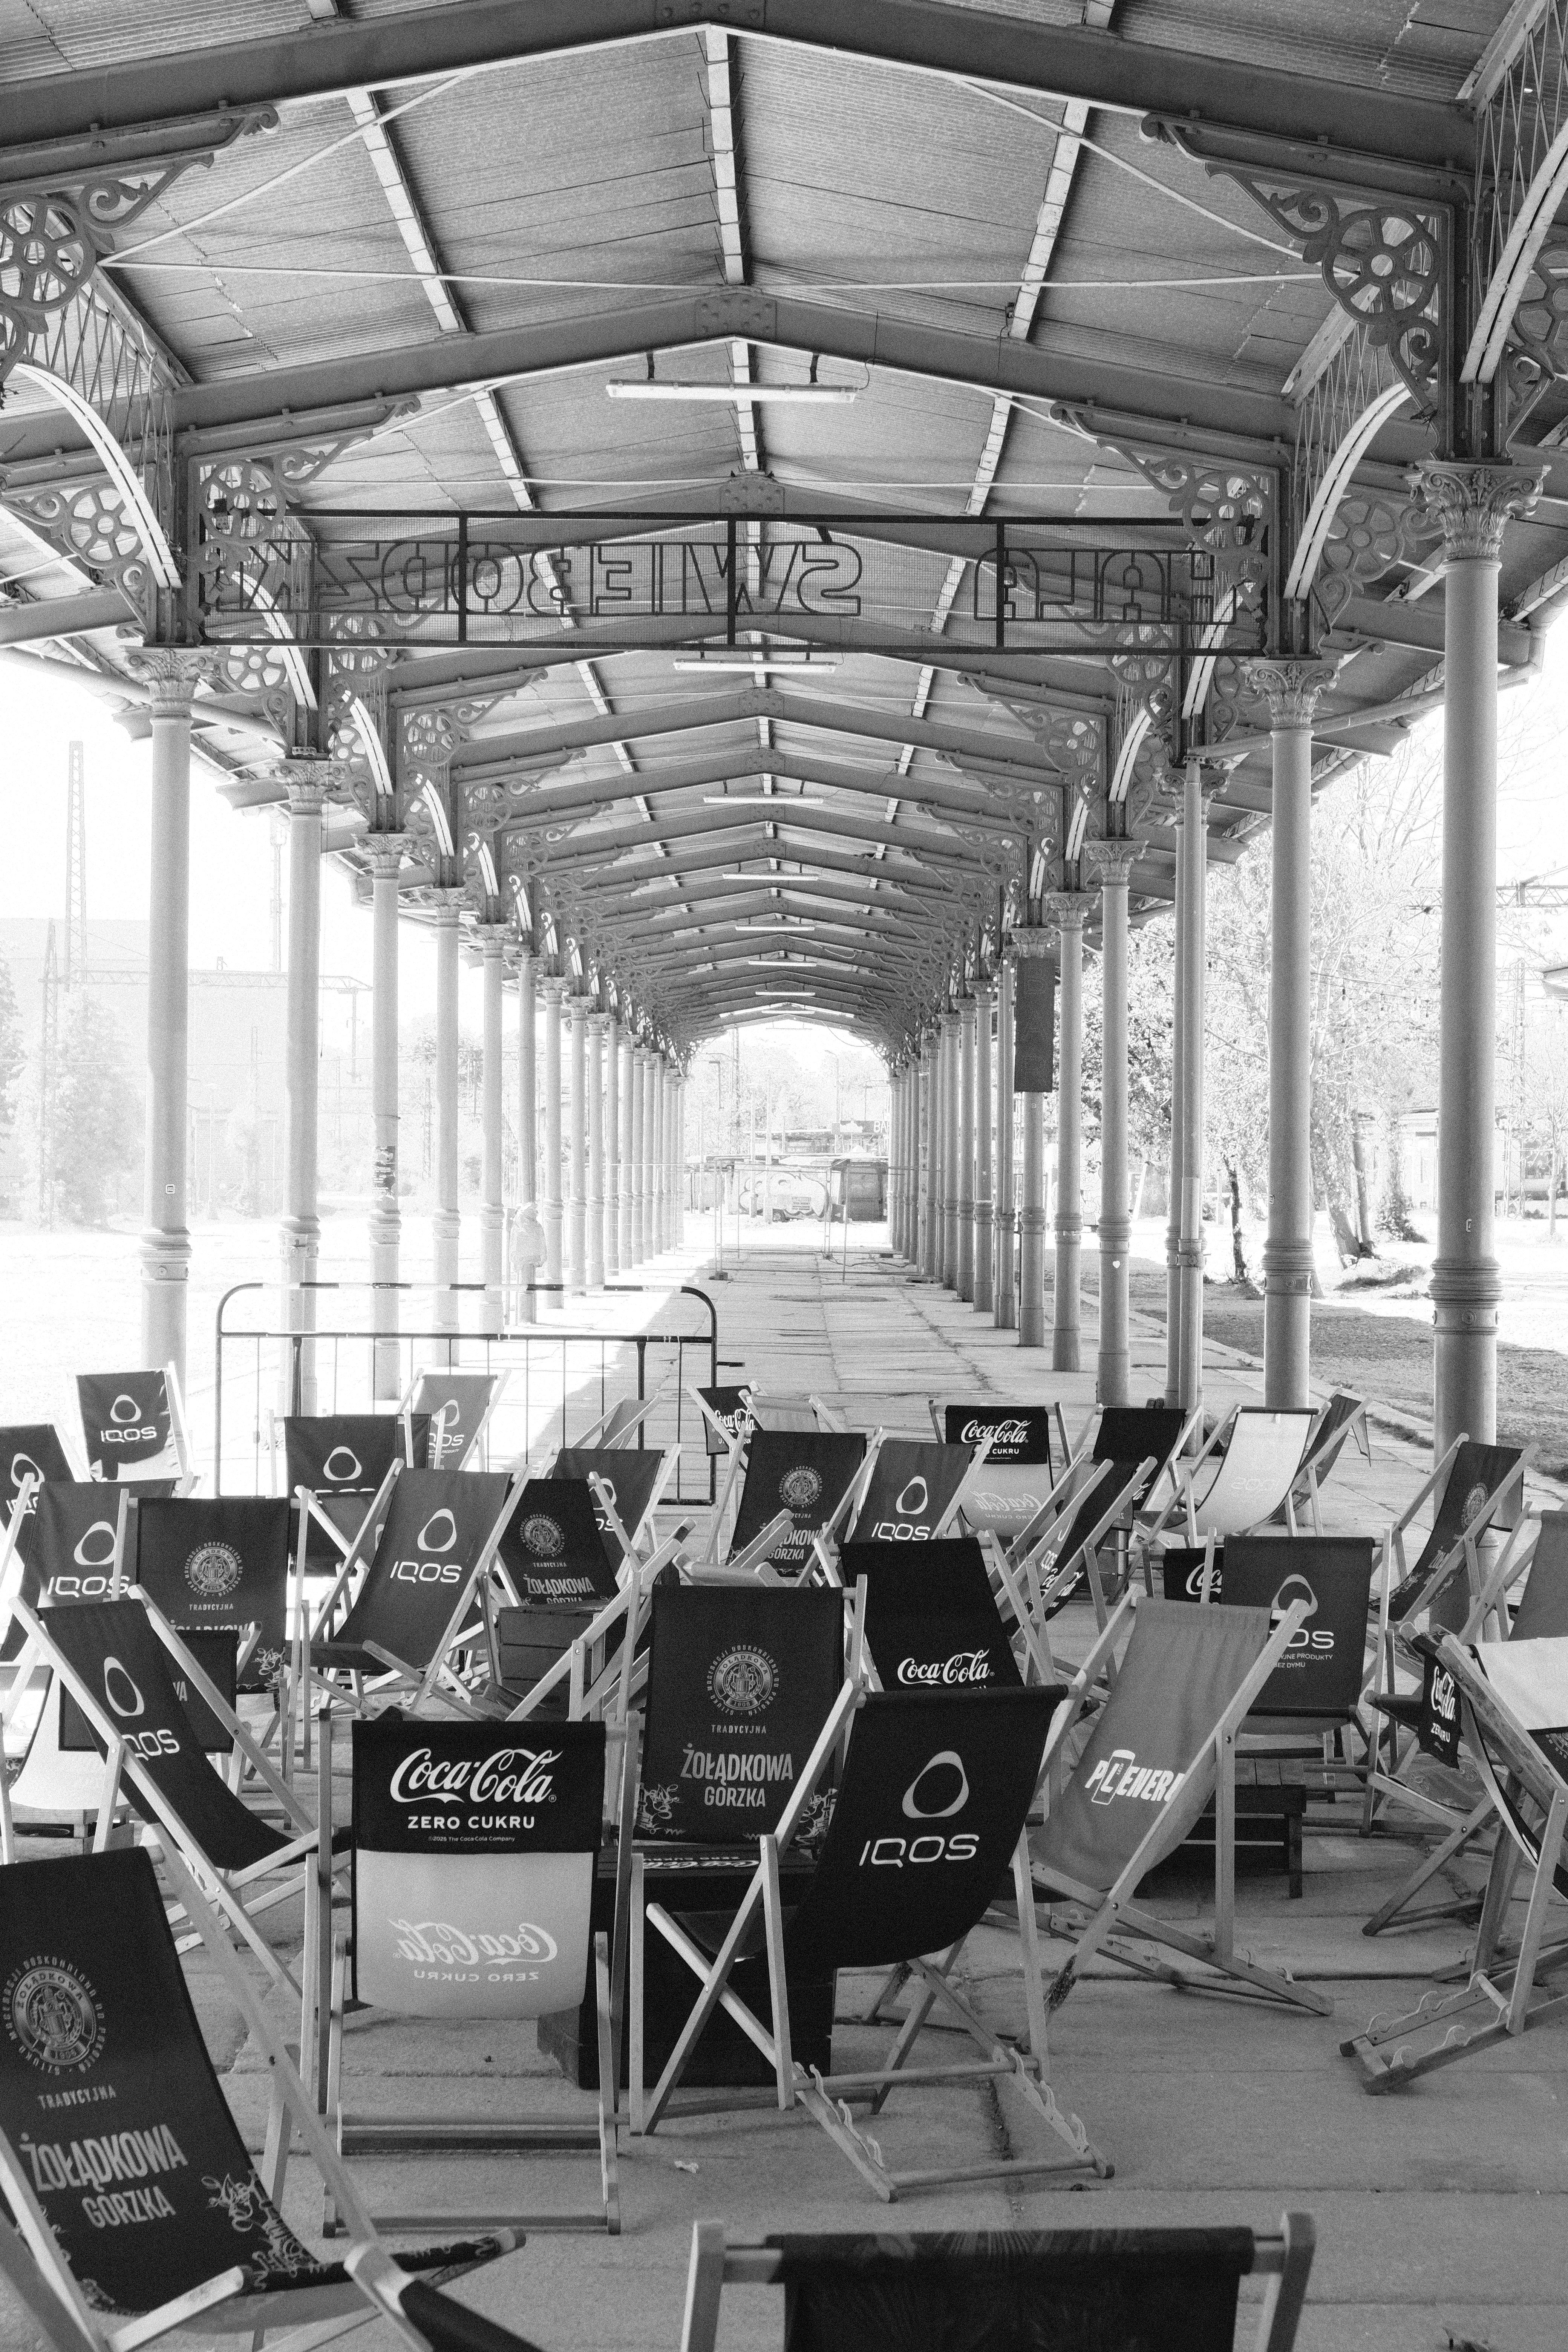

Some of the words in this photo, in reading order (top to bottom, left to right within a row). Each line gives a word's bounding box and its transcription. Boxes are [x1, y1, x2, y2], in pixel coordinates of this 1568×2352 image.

[101, 1426, 156, 1442] IQOS
[961, 1419, 1032, 1443] Coca-Cola
[871, 1522, 930, 1542] IQOS
[390, 1561, 461, 1583] IQOS
[47, 1576, 130, 1598] IQOS
[523, 1574, 595, 1598] ŻOŁĄDKOWA
[897, 1649, 990, 1685] Coca-Cola
[712, 1724, 767, 1734] TRADYCYJNA
[122, 1729, 180, 1761] QOS
[390, 1748, 564, 1804] Coca-Cola
[680, 1743, 793, 1786] ŻOŁĄDKOWA
[704, 1786, 766, 1807] GORZKA
[408, 1816, 460, 1829] ZERO
[468, 1816, 535, 1829] CUKRU
[859, 1834, 980, 1868] IQOS
[38, 2085, 116, 2109] TRADYCYJNA
[21, 2124, 188, 2193] ŻOŁĄDKOWA
[81, 2186, 176, 2228] GORZKA
